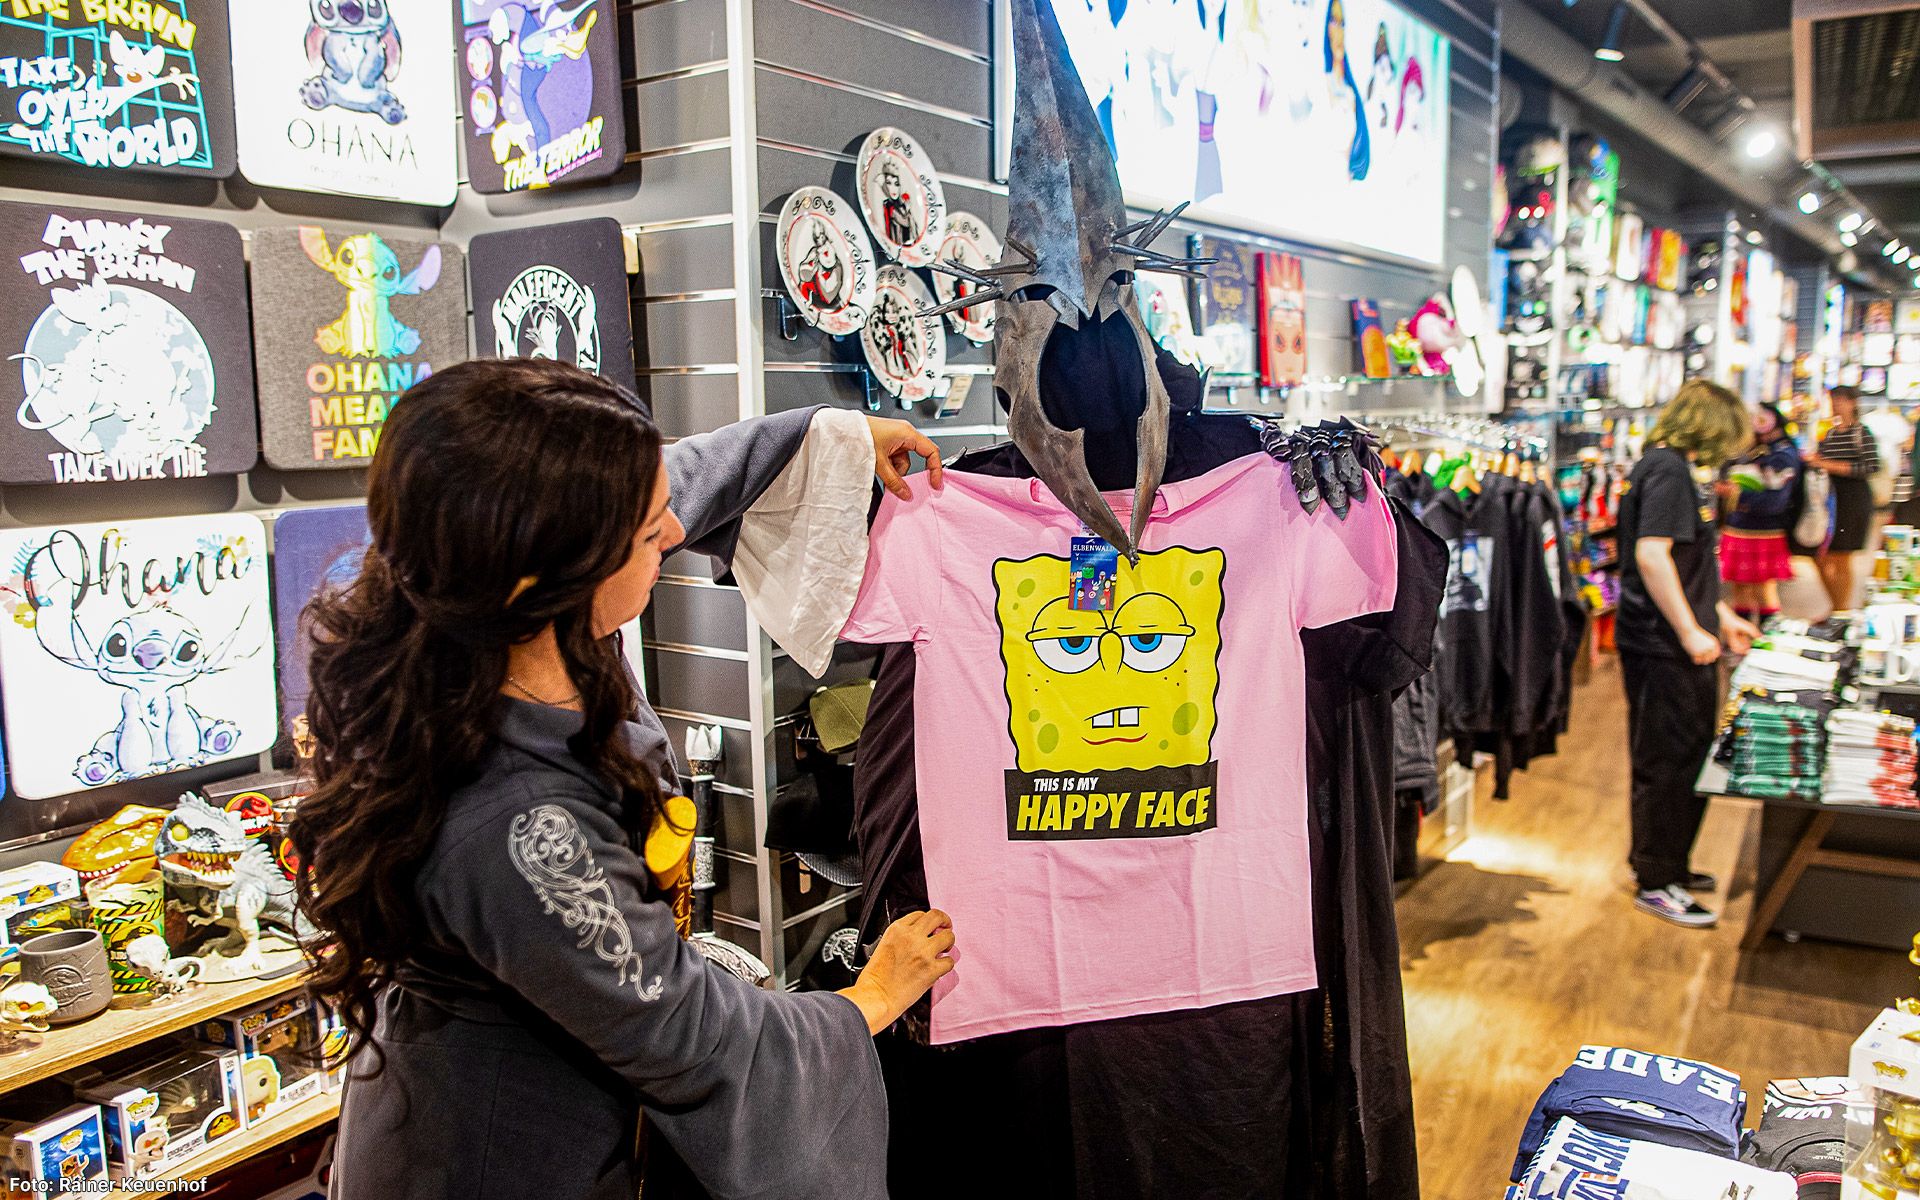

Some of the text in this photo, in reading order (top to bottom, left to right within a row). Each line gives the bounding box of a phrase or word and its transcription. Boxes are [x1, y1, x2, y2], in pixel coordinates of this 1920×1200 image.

[80, 0, 197, 50] BRAIN
[0, 56, 73, 88] TAKE
[16, 89, 110, 125] OVER
[28, 117, 198, 168] THE WORLD
[288, 118, 418, 170] OHANA
[18, 249, 86, 286] THE
[94, 253, 196, 294] BRAIN
[502, 270, 587, 327] MALEFICENT
[306, 361, 433, 394] OHANA
[310, 394, 400, 428] MEA
[312, 427, 383, 461] FAM
[48, 446, 208, 484] TAKE OVER THE
[1072, 543, 1116, 552] ELBENWALD
[24, 528, 252, 611] Ohana
[1034, 776, 1100, 791] THIS IS MY
[1016, 786, 1212, 832] HAPPY FACE
